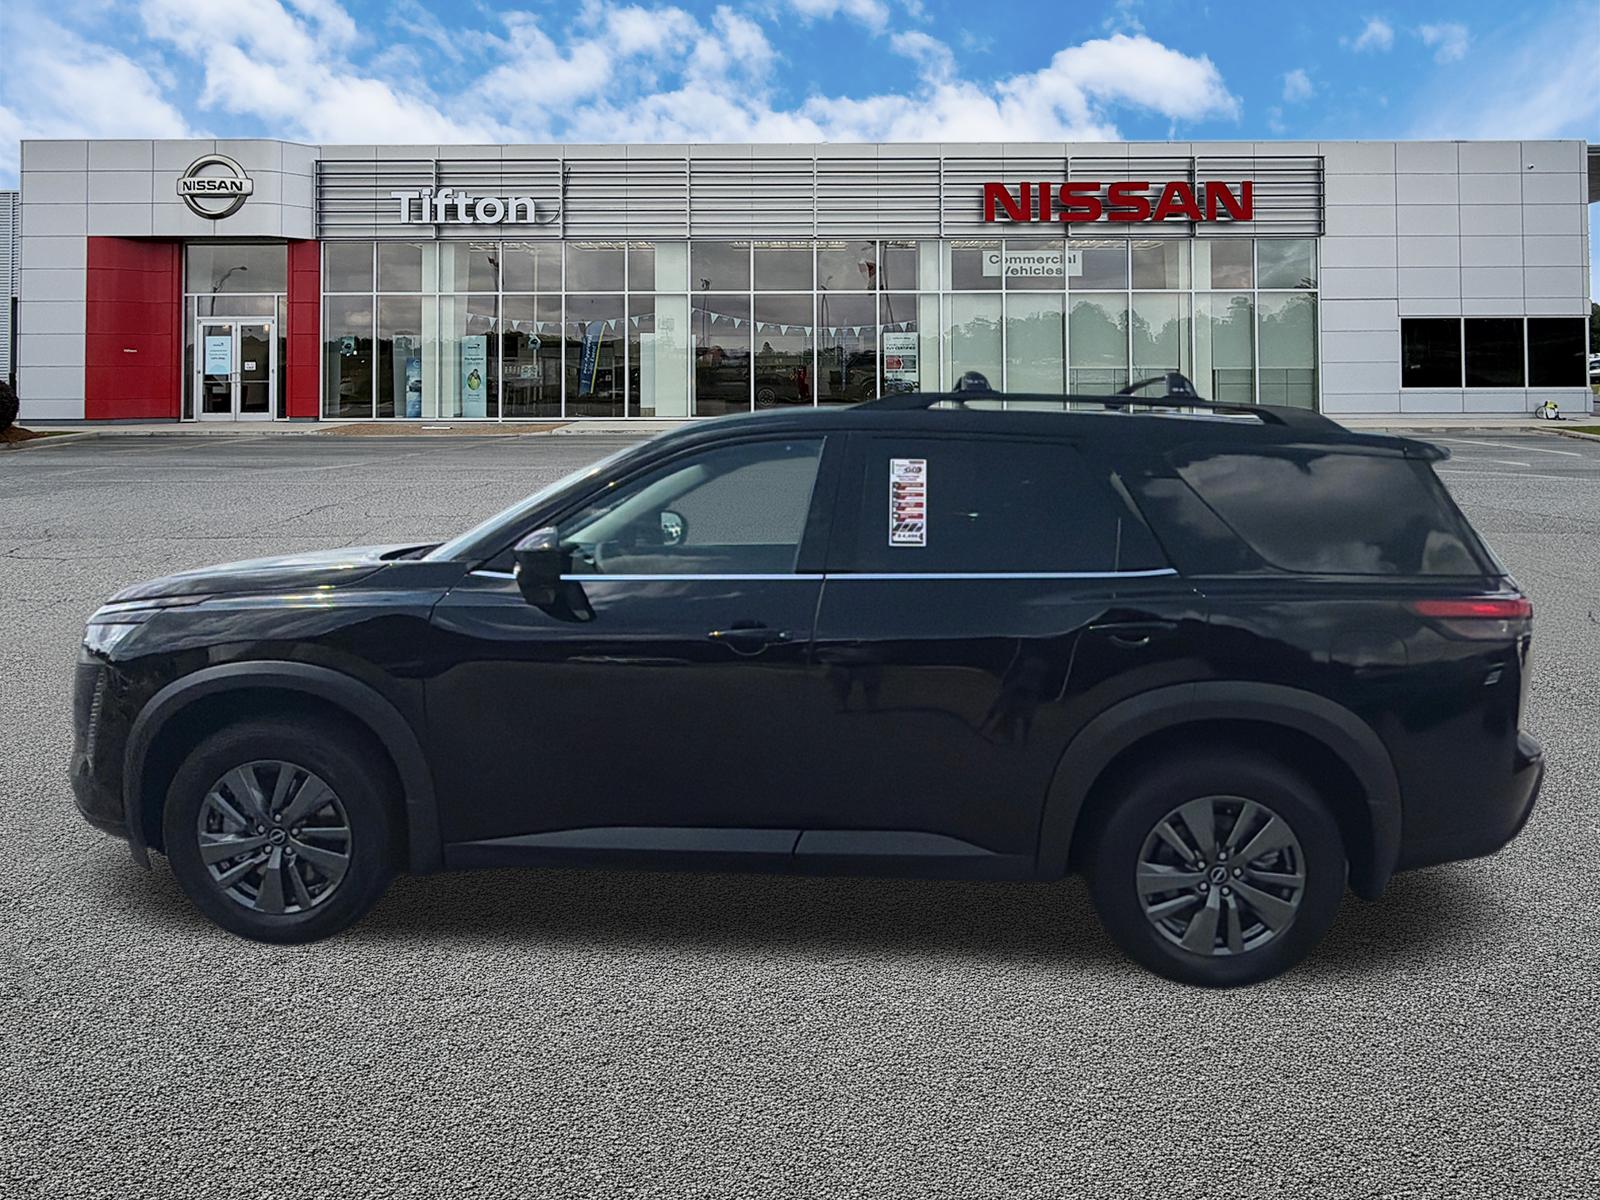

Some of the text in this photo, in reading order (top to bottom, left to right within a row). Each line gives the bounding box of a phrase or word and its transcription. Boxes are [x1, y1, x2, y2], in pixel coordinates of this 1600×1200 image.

[182, 180, 243, 192] NISSAN
[983, 180, 1253, 222] NISSAN
[390, 187, 536, 224] Tifton
